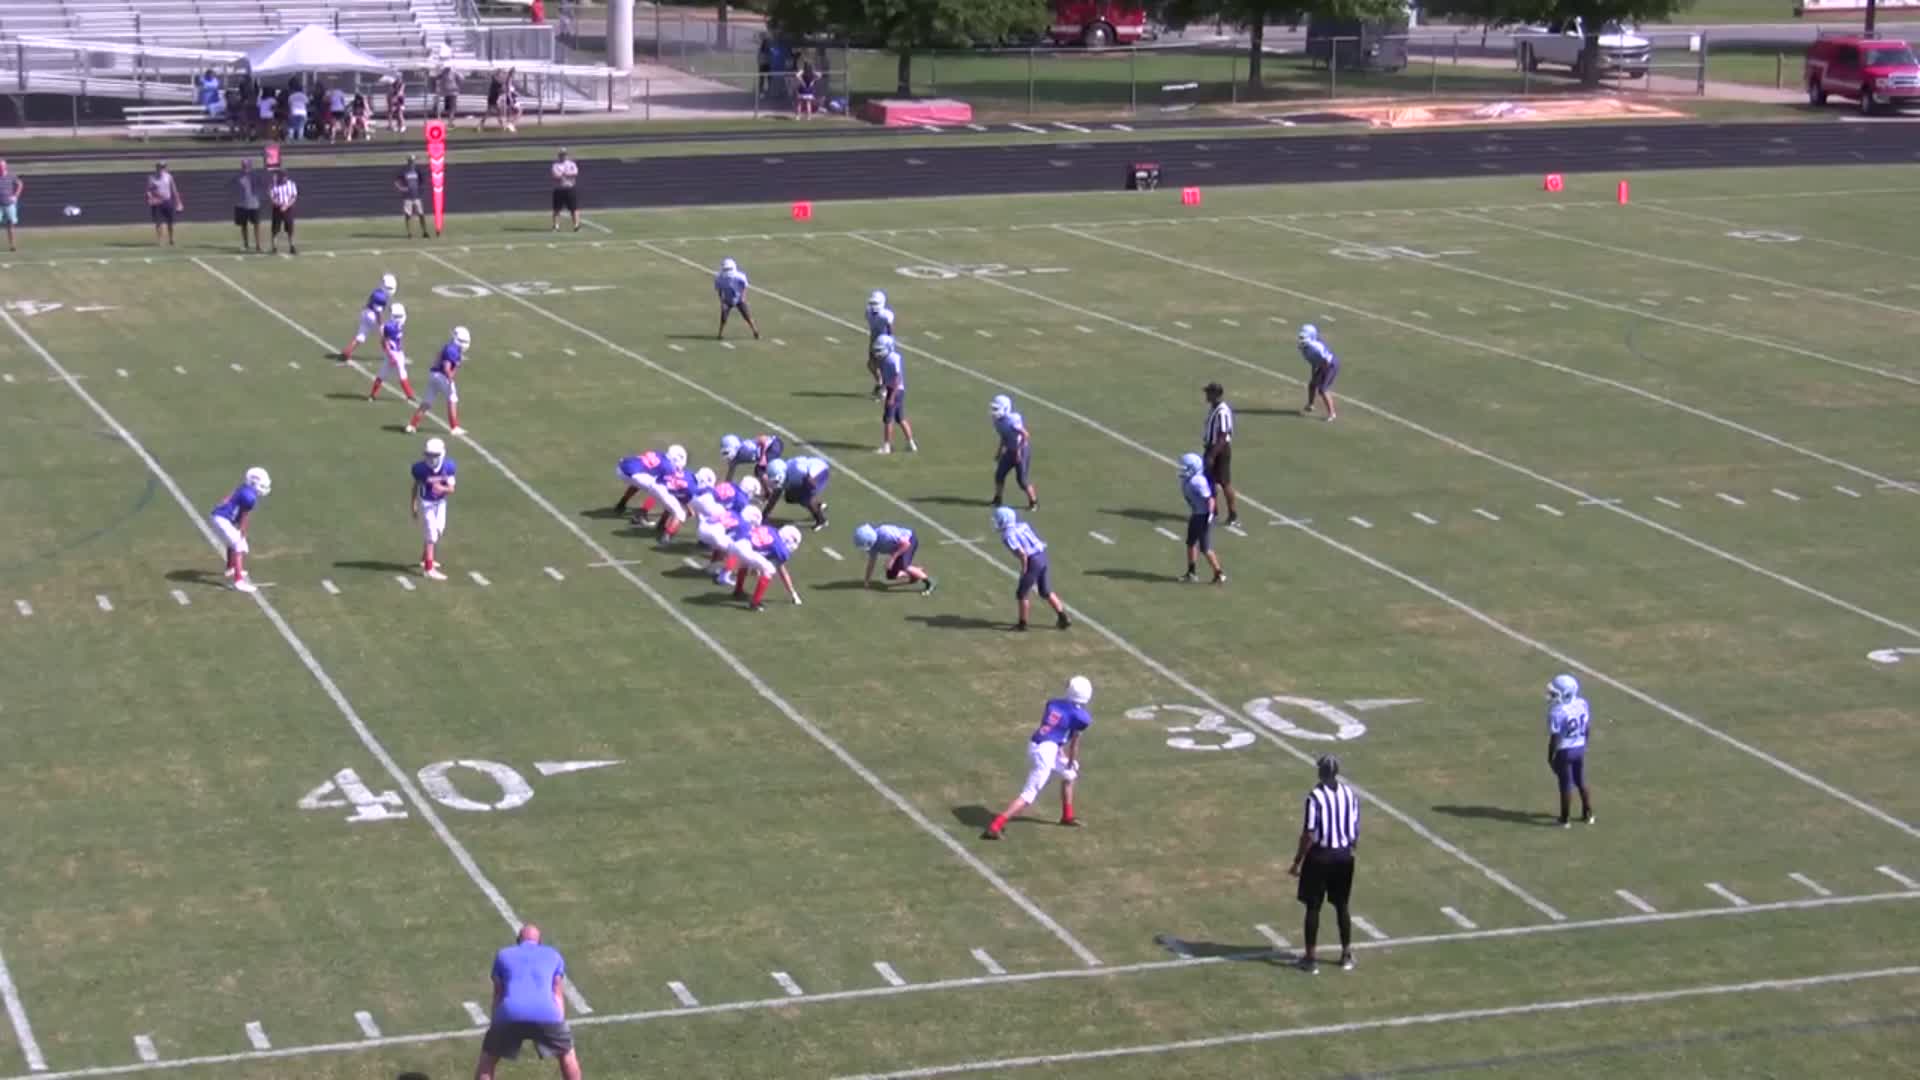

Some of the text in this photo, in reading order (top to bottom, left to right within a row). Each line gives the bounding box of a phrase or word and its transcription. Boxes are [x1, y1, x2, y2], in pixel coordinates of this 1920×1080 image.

[431, 281, 566, 299] 30
[1124, 696, 1366, 750] 30
[298, 759, 535, 822] 40
